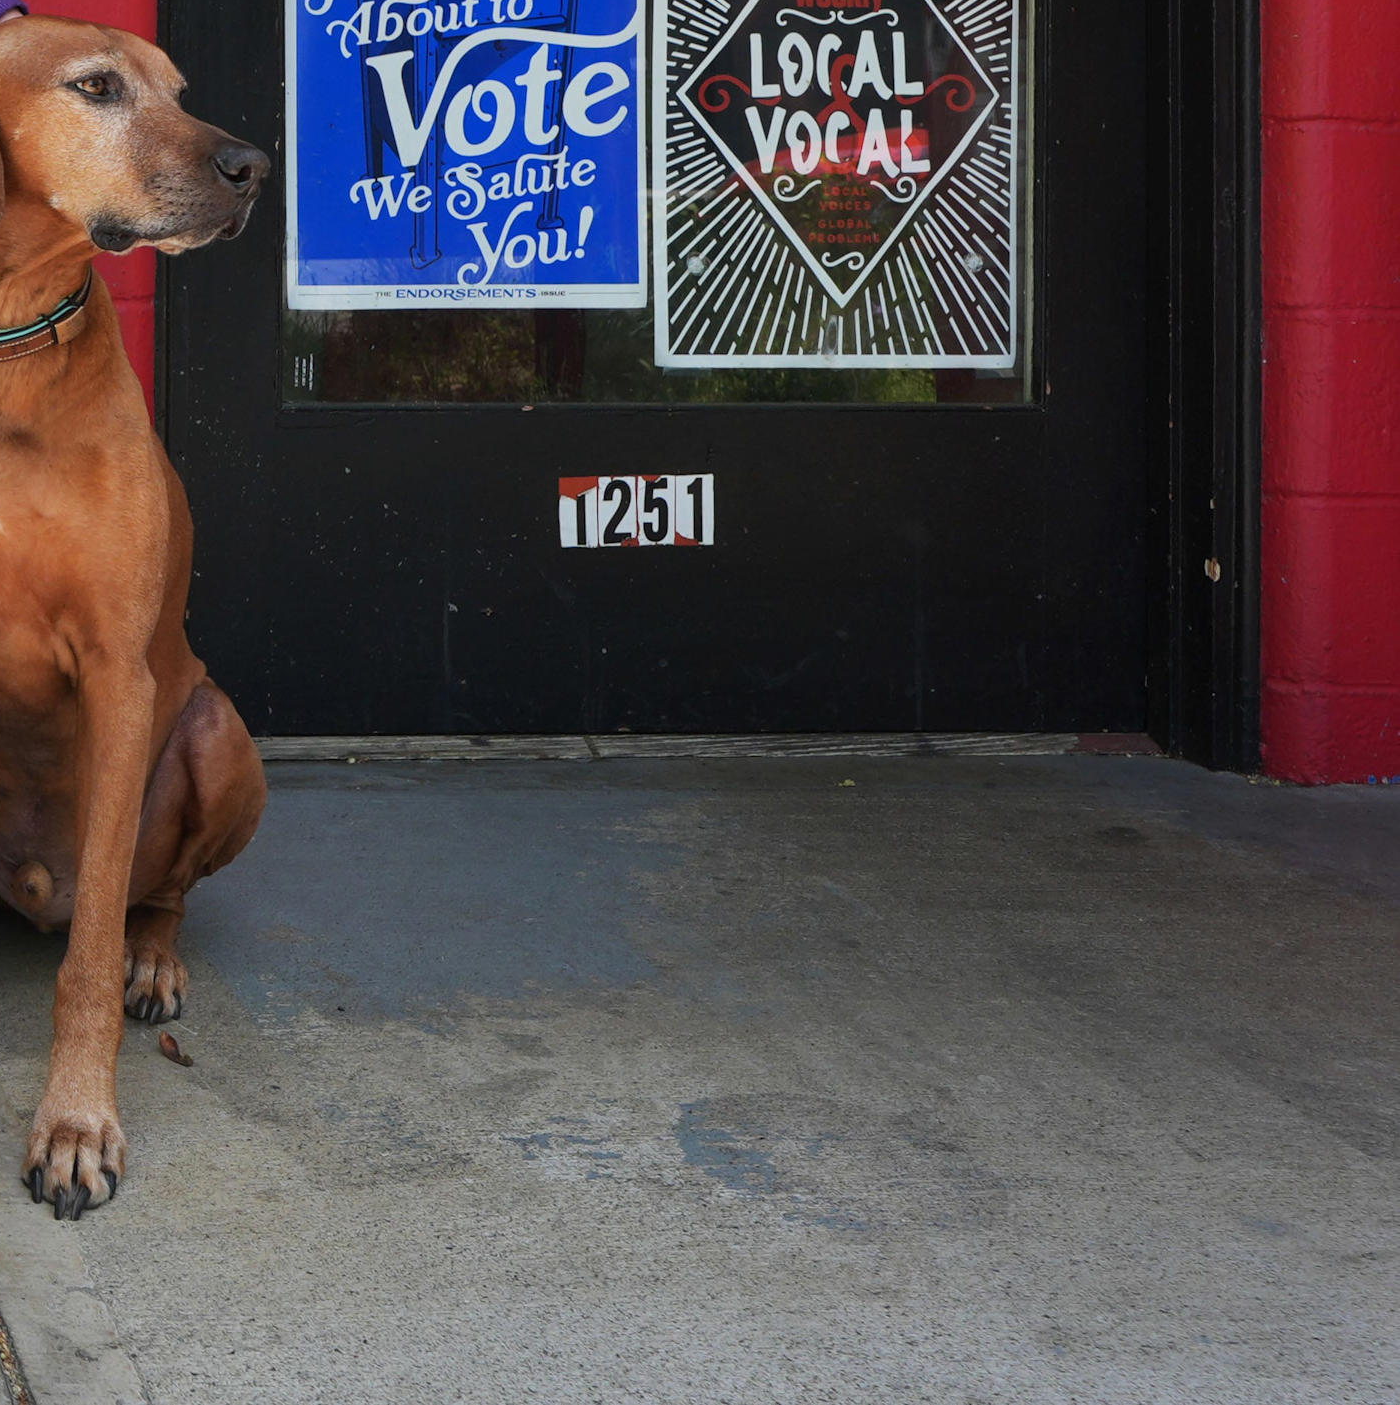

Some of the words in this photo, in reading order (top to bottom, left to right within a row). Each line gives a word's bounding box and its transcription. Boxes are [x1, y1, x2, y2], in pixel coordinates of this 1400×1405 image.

[365, 14, 638, 168] Vote
[749, 29, 924, 101] LOCAL
[744, 106, 931, 178] VOCAL
[350, 172, 432, 221] We
[445, 145, 597, 221] Salute
[819, 200, 872, 211] VOICES
[824, 186, 868, 196] LOCAL
[817, 219, 872, 229] GLOBAL
[395, 288, 537, 301] ENDORSEMENTS
[576, 477, 704, 546] 1251
